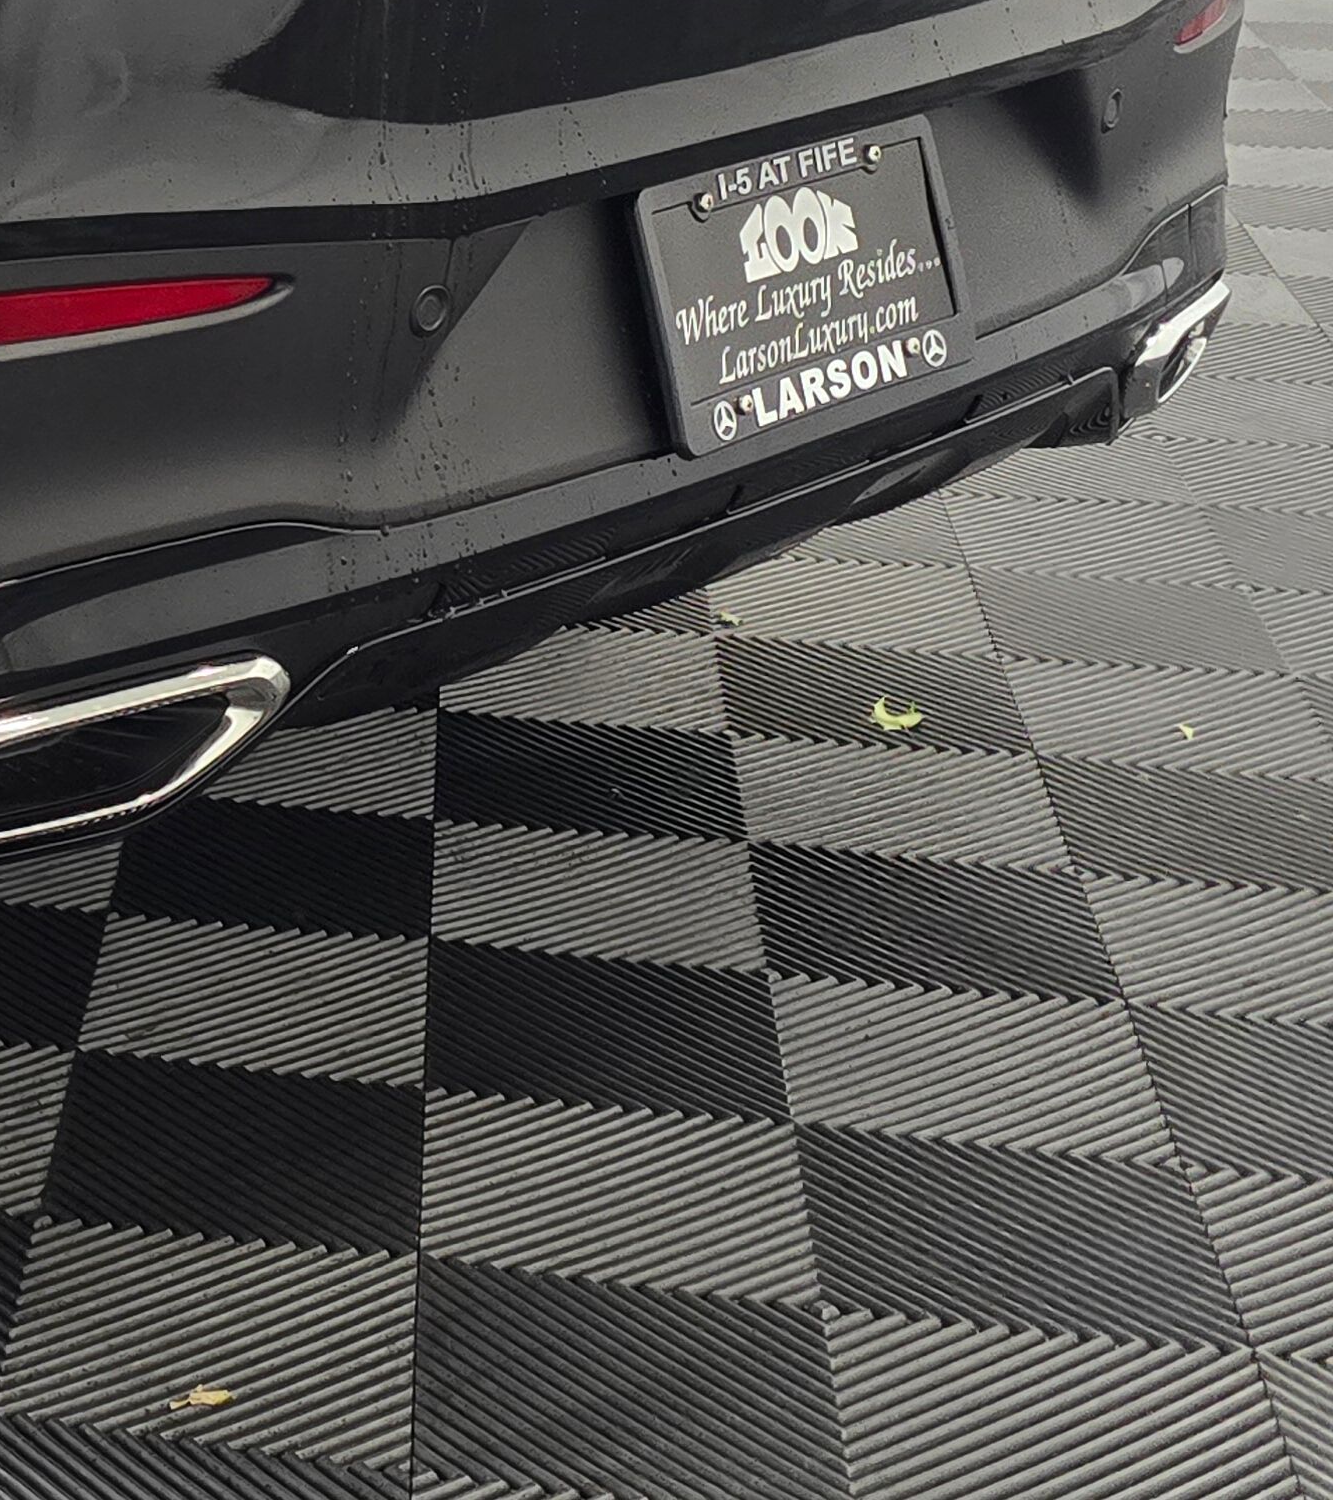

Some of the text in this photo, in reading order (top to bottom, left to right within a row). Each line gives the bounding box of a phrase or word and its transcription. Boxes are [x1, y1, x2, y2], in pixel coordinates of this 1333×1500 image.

[718, 138, 858, 200] I-5 AT FIFE
[675, 238, 942, 345] Where Luxury Resides...
[719, 296, 919, 385] LarsonLuxury.com
[751, 340, 907, 427] LARSON
